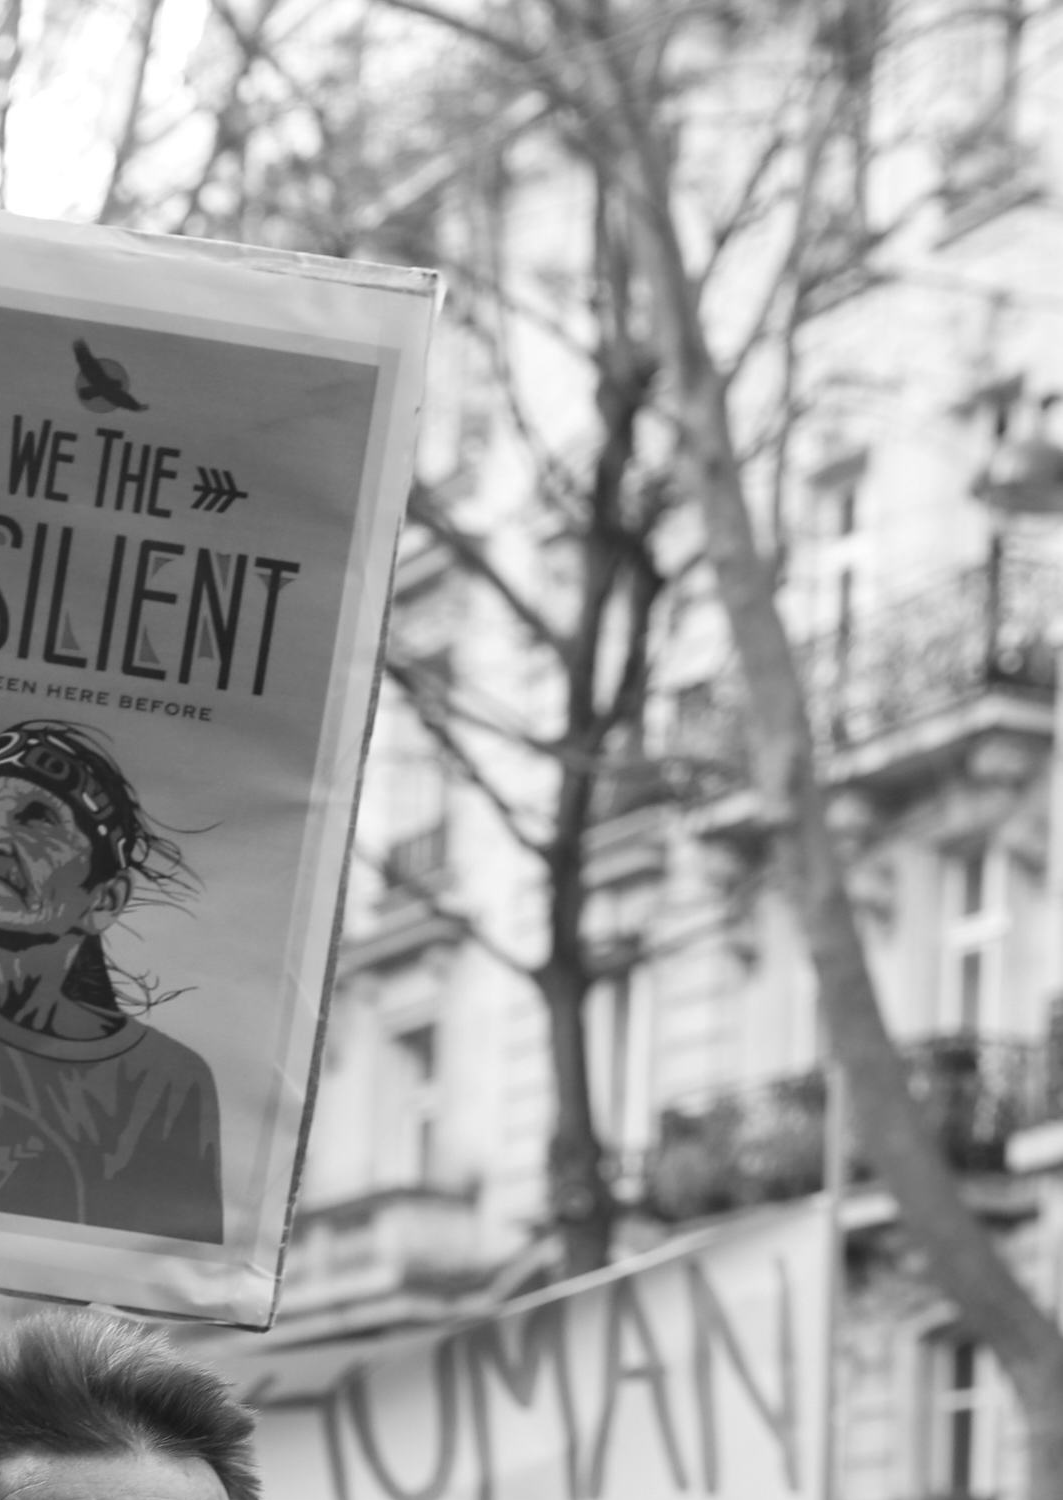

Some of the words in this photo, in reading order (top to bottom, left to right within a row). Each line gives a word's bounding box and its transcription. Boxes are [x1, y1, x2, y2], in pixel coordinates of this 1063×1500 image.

[8, 414, 78, 502] WE
[94, 427, 181, 518] THE
[46, 683, 110, 706] HERE
[118, 694, 213, 722] BEFORE
